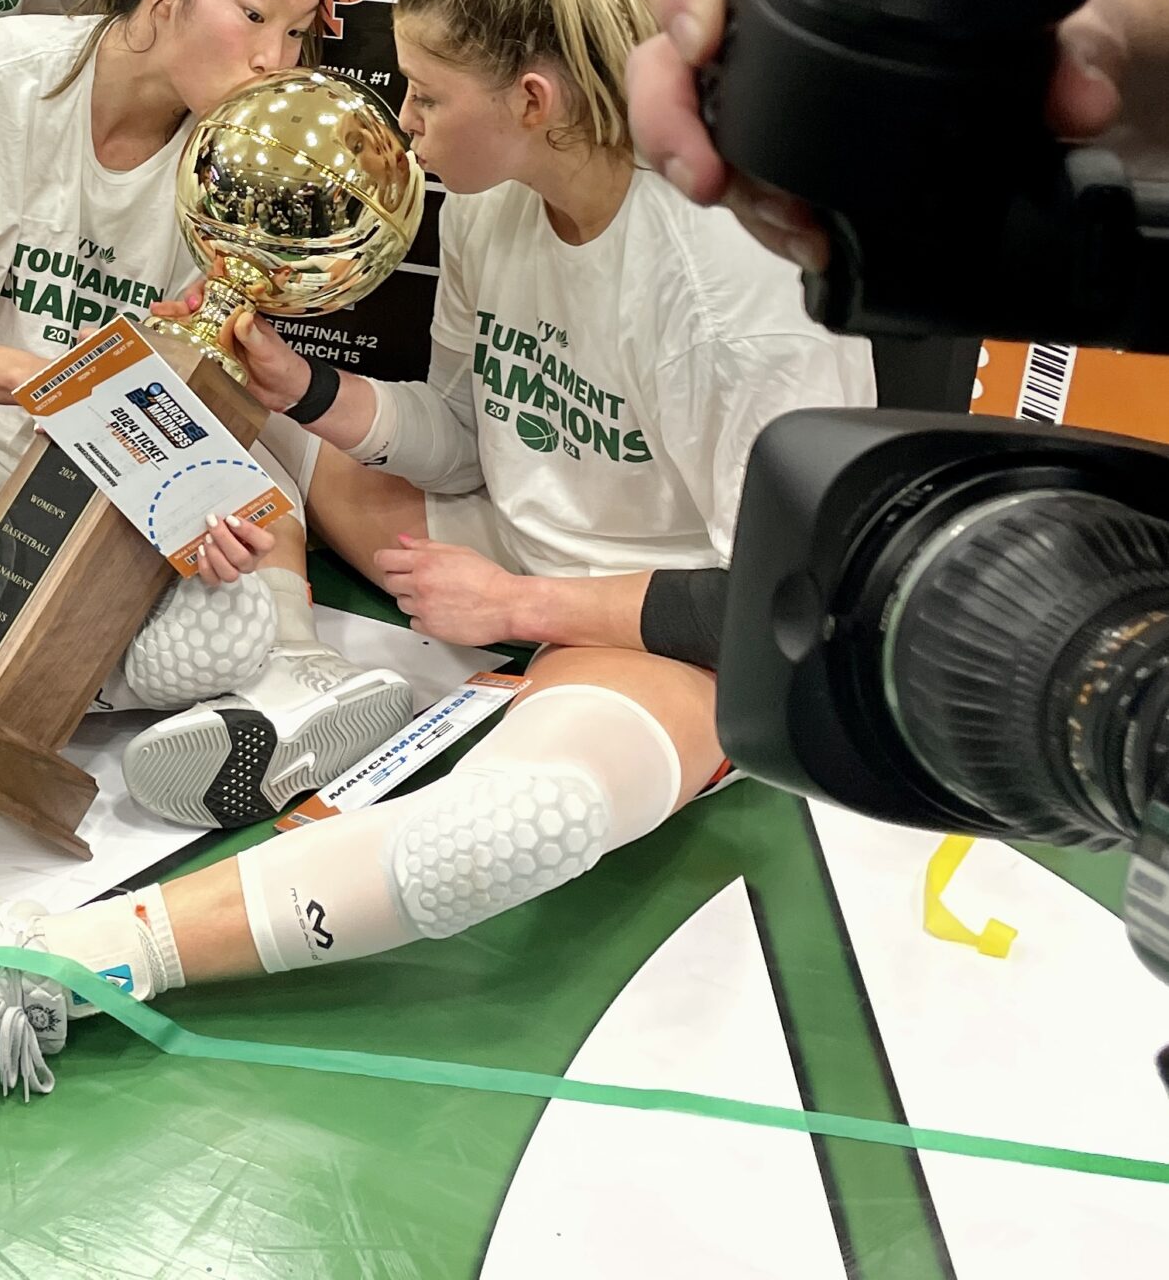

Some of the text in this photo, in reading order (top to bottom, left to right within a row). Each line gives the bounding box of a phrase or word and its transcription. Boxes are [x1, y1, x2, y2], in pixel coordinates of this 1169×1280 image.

[46, 326, 68, 343] 20
[265, 318, 378, 349] EMIFINAL #2
[343, 350, 361, 364] 15
[147, 403, 193, 448] MADNESS
[155, 392, 191, 427] MARCH
[487, 401, 508, 420] 20
[110, 407, 169, 463] 2024 TICKET
[110, 421, 151, 465] PUNCHED
[58, 466, 78, 481] 2024
[30, 494, 66, 519] WOMEN'S
[2, 523, 51, 556] BASKETBALL
[328, 689, 477, 801] MARCHMADNESS
